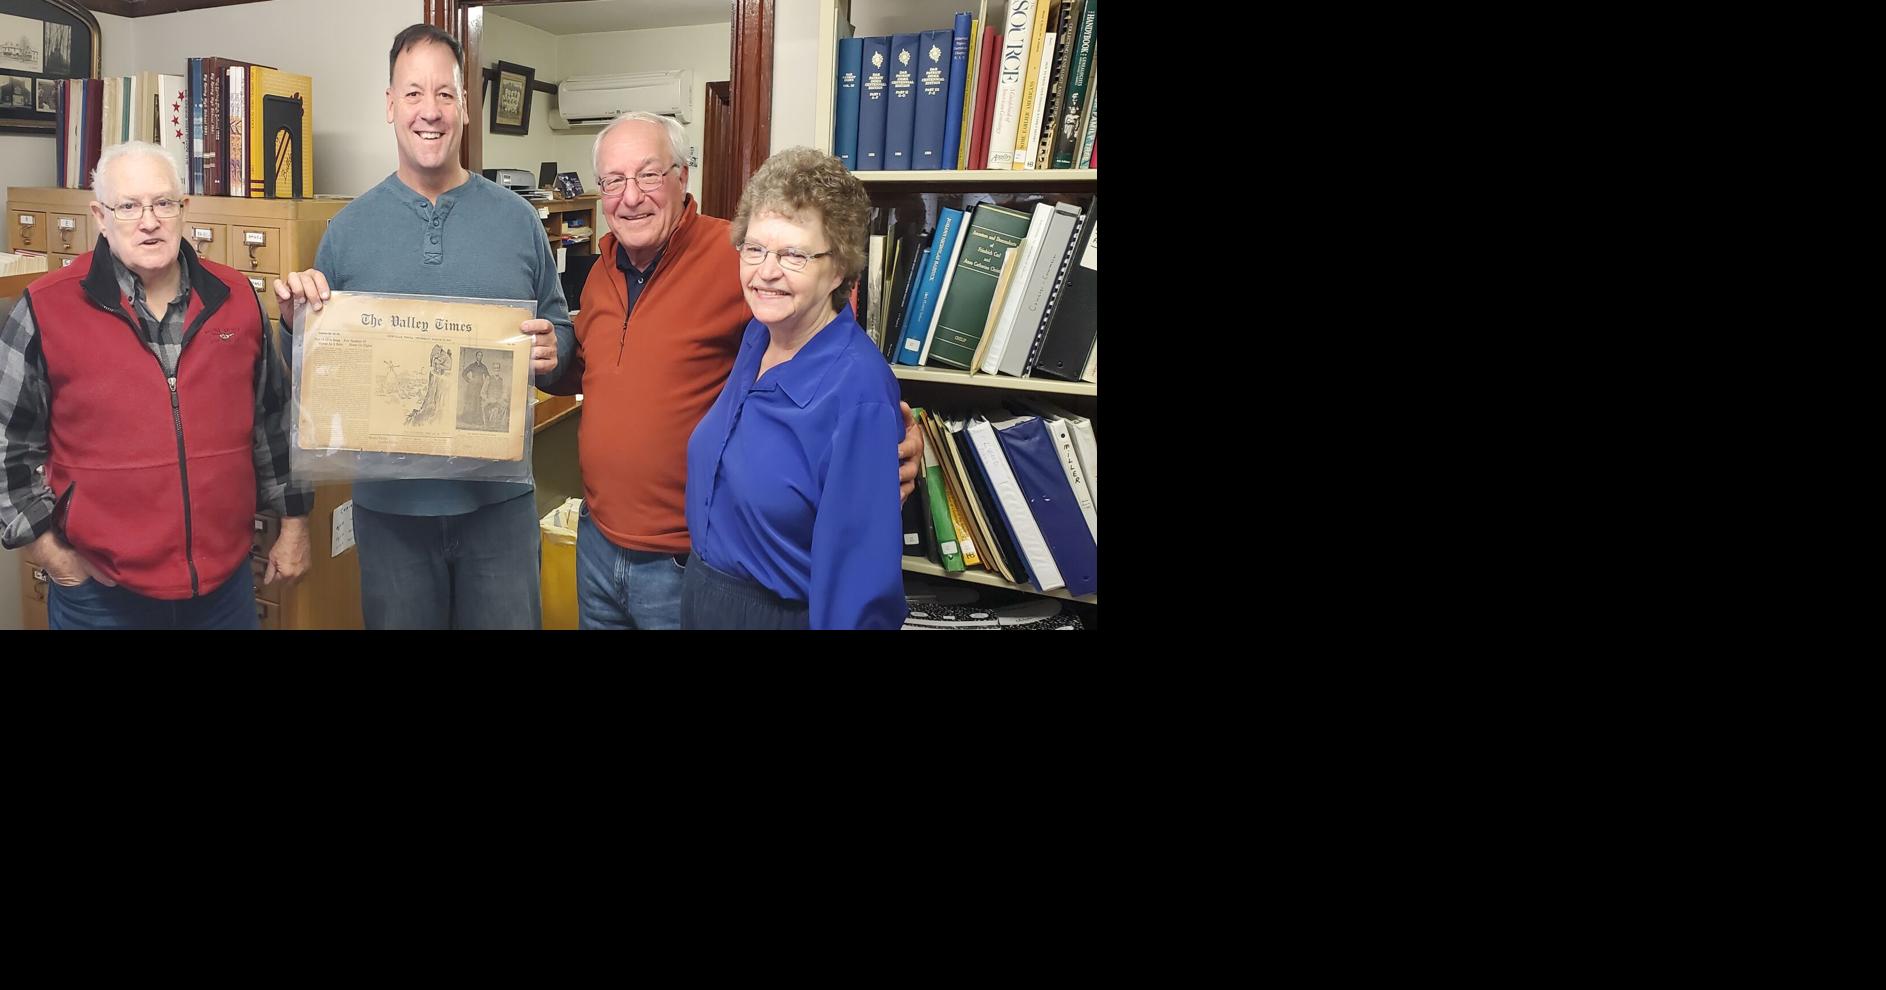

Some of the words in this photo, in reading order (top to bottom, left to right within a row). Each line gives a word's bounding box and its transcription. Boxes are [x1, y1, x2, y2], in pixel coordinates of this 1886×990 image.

[1002, 0, 1029, 84] SOURCE
[1081, 13, 1095, 53] HANDYBOOK
[361, 313, 383, 328] The
[391, 315, 429, 332] Valley
[434, 318, 472, 333] Times
[1064, 443, 1080, 484] MILLER
